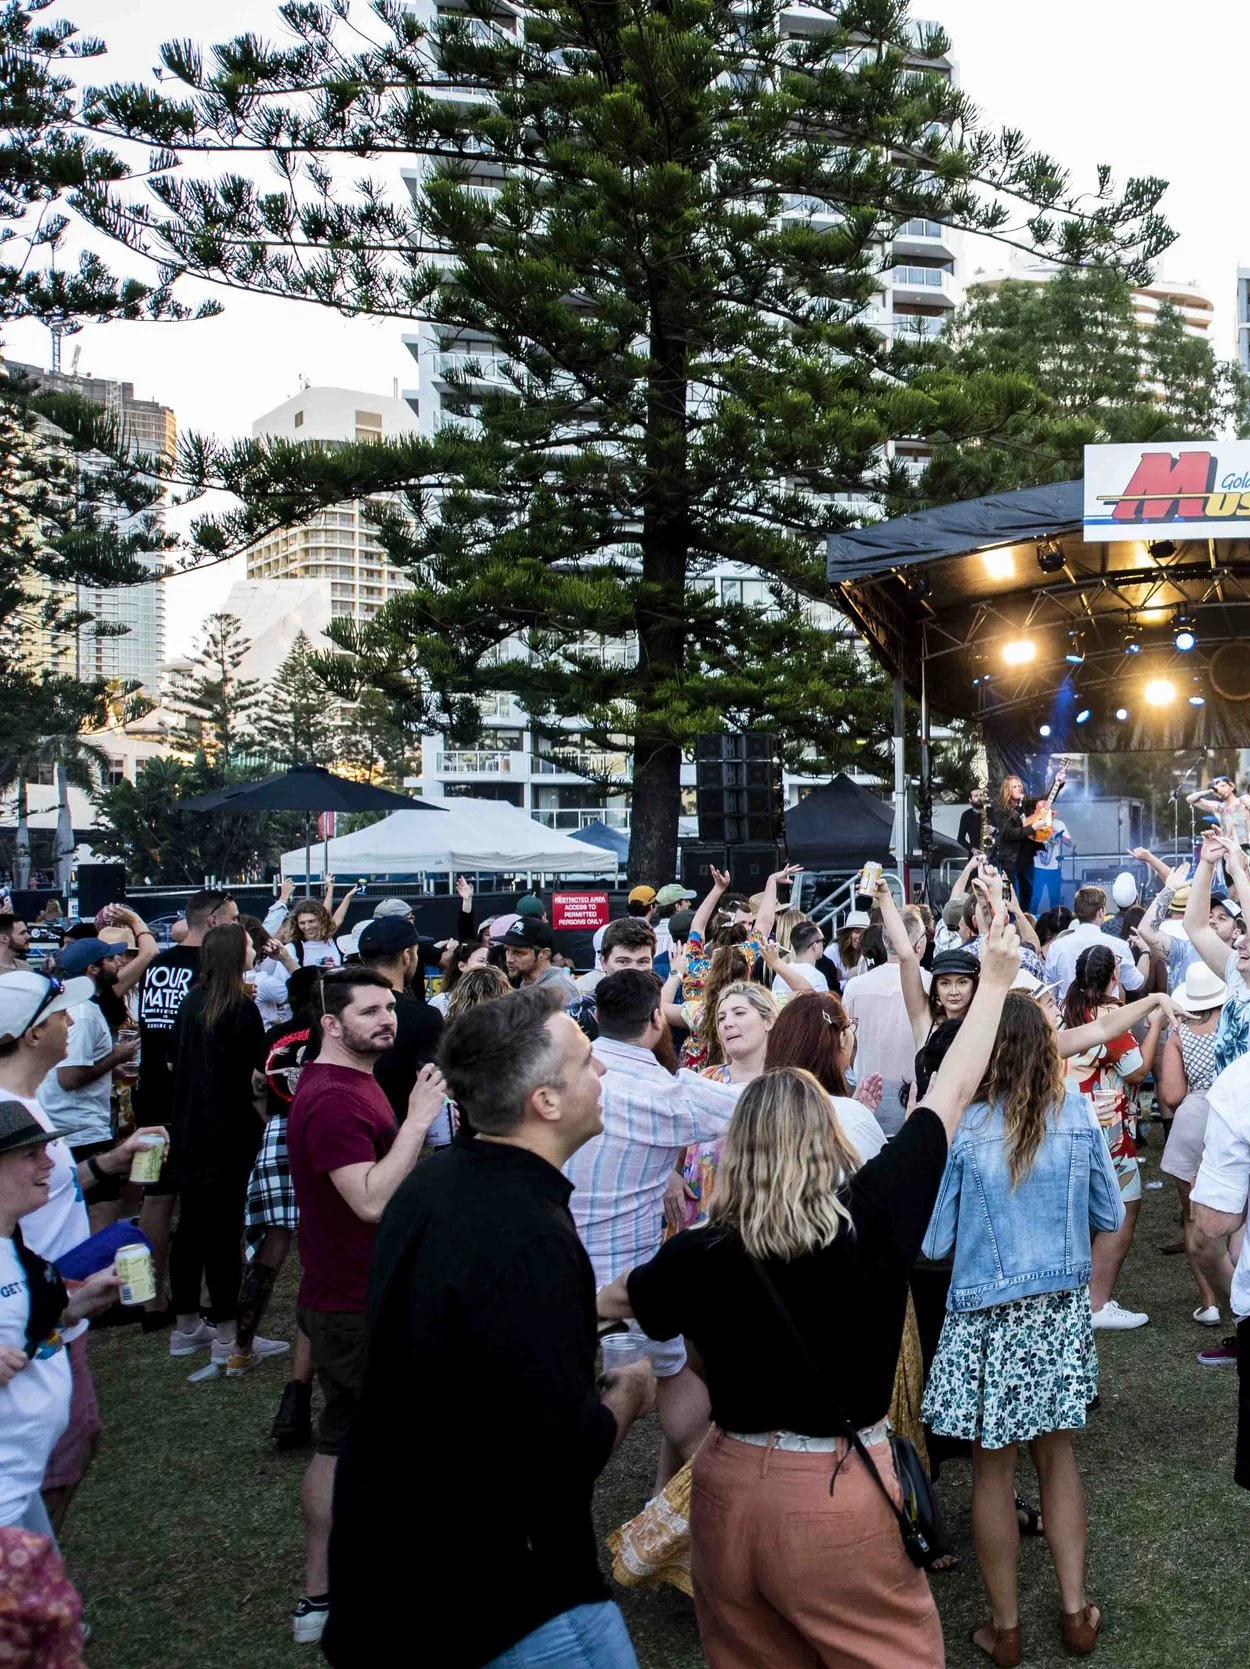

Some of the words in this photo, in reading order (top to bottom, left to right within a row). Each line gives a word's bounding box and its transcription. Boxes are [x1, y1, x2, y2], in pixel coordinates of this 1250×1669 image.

[555, 896, 589, 904] RESTRICTED
[589, 896, 607, 904] AREA
[145, 966, 193, 993] YOUR
[141, 987, 186, 1012] MATES
[1, 1281, 22, 1298] GET
